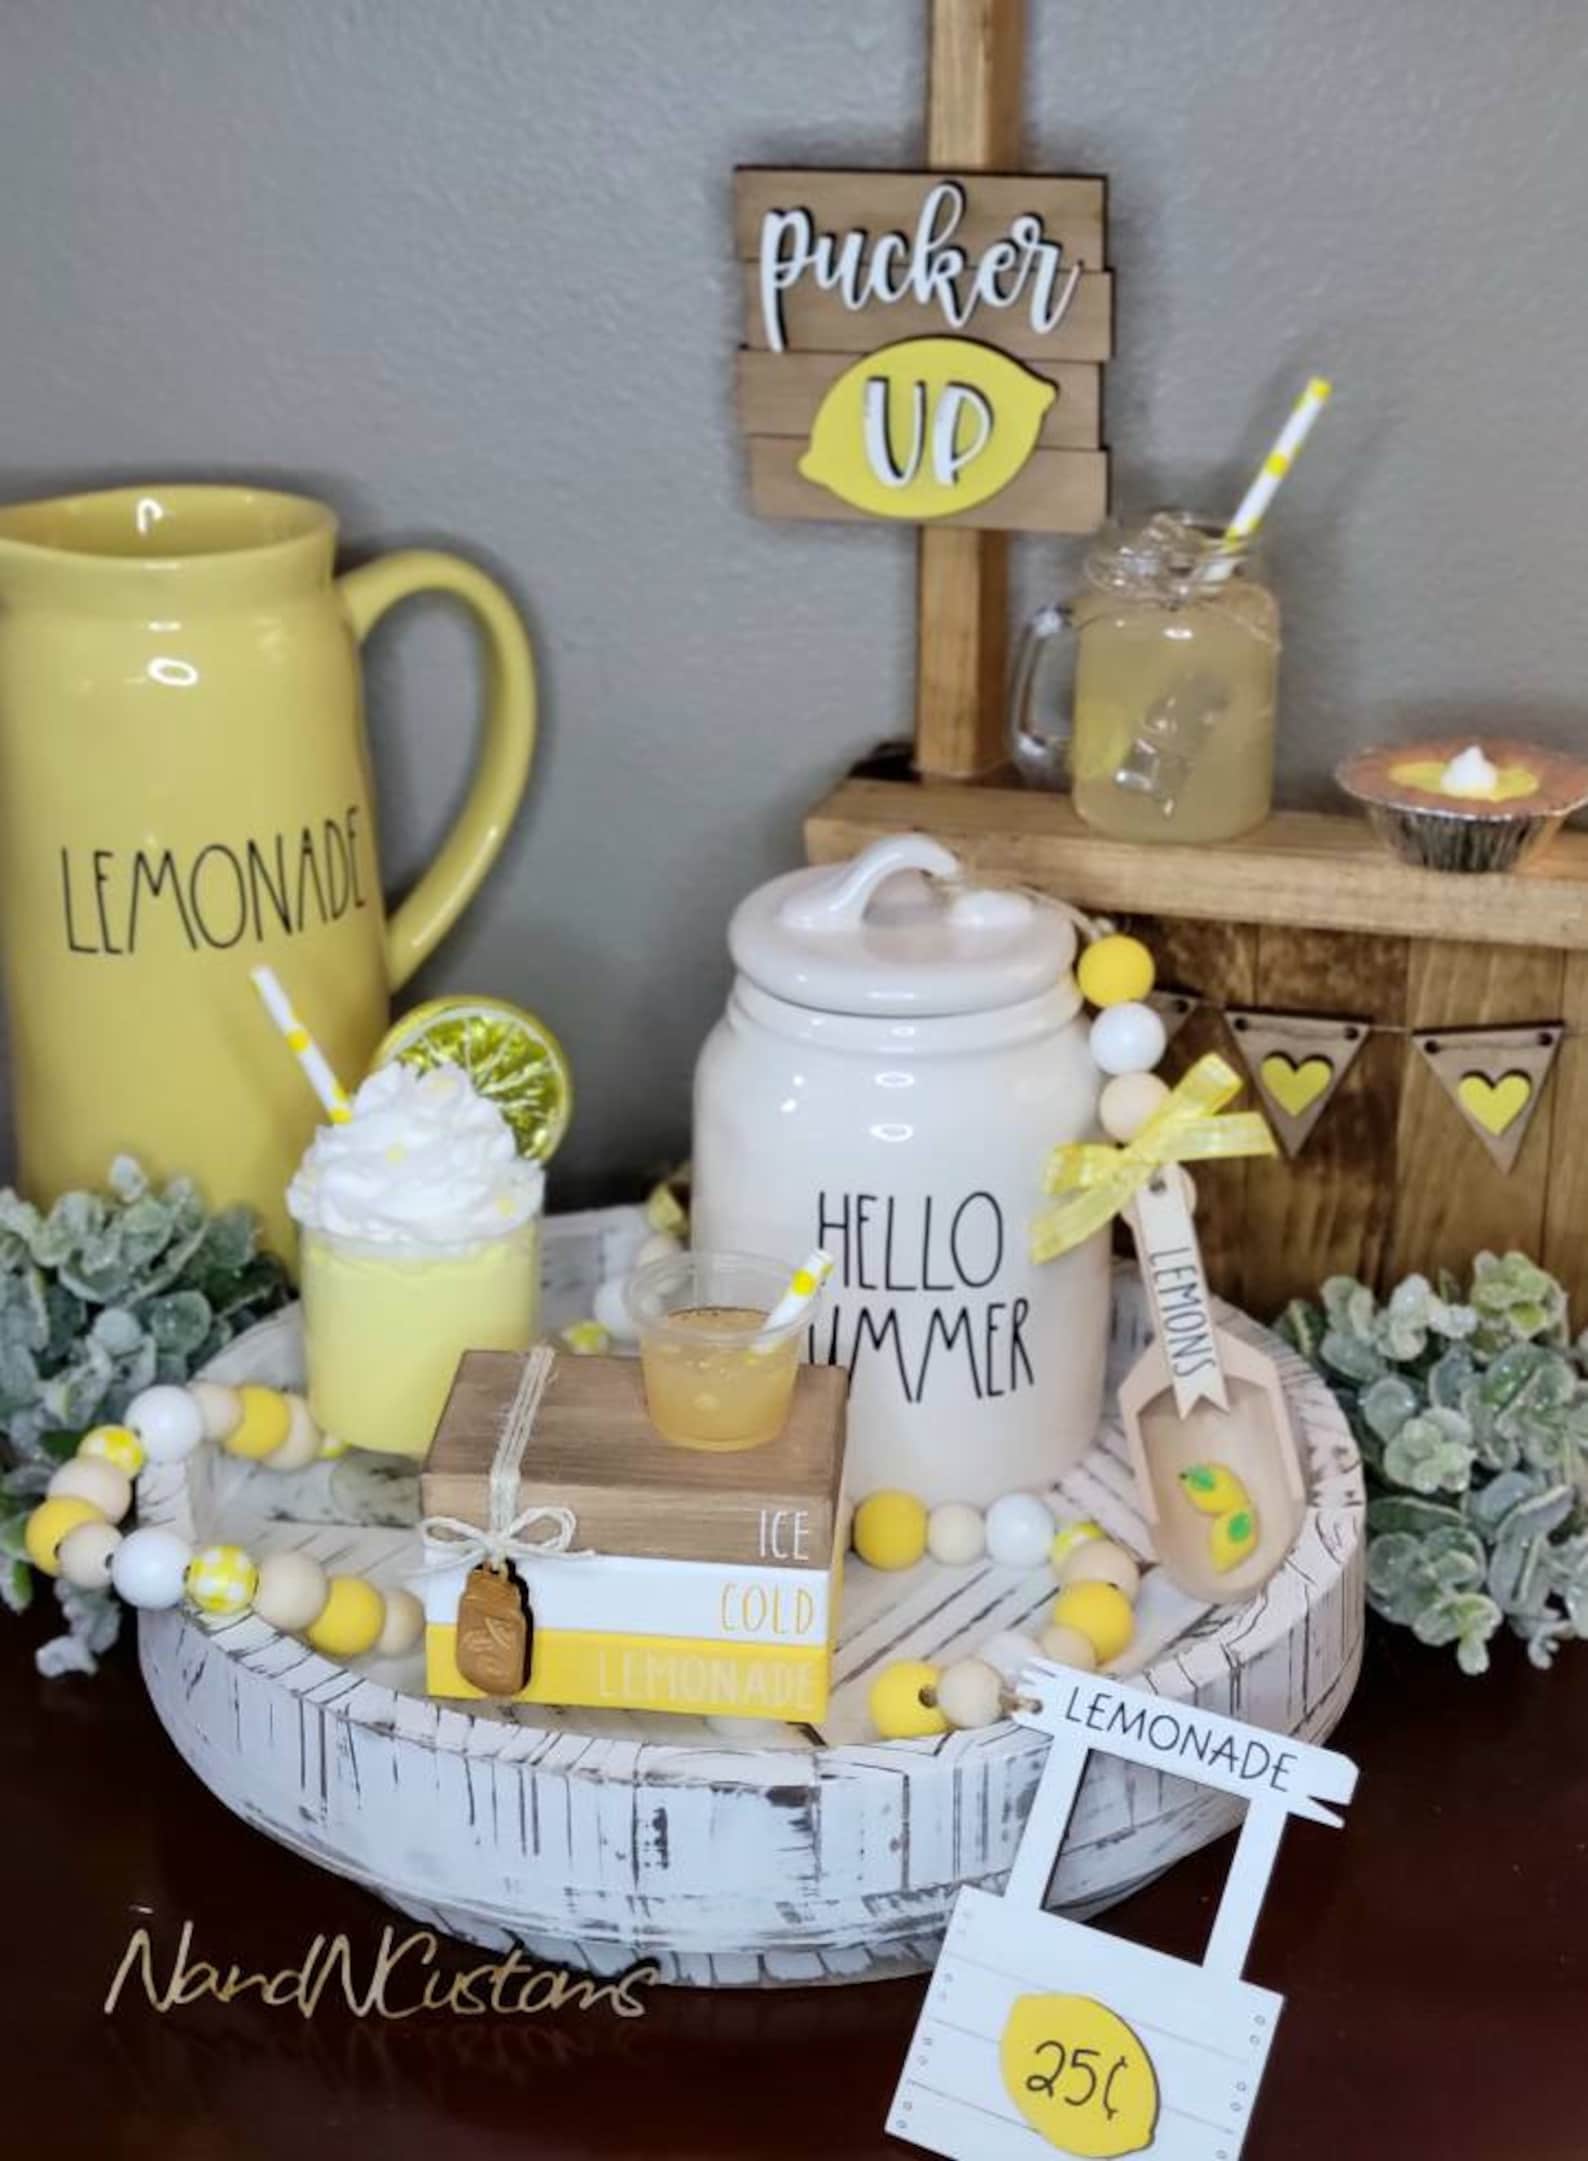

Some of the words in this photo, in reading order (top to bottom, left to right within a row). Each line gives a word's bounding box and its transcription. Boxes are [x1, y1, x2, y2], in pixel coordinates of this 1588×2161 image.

[761, 178, 1083, 353] pucker
[864, 376, 994, 488] UP
[61, 805, 366, 954] LEMONADE
[818, 1190, 1004, 1291] HELLO
[807, 1297, 1034, 1403] UMMER
[1150, 1247, 1216, 1377] LEMONS
[759, 1509, 809, 1560] ICE
[721, 1582, 815, 1636] COLD
[598, 1648, 817, 1711] LEMONADE
[1064, 1686, 1298, 1792] LEMONADE
